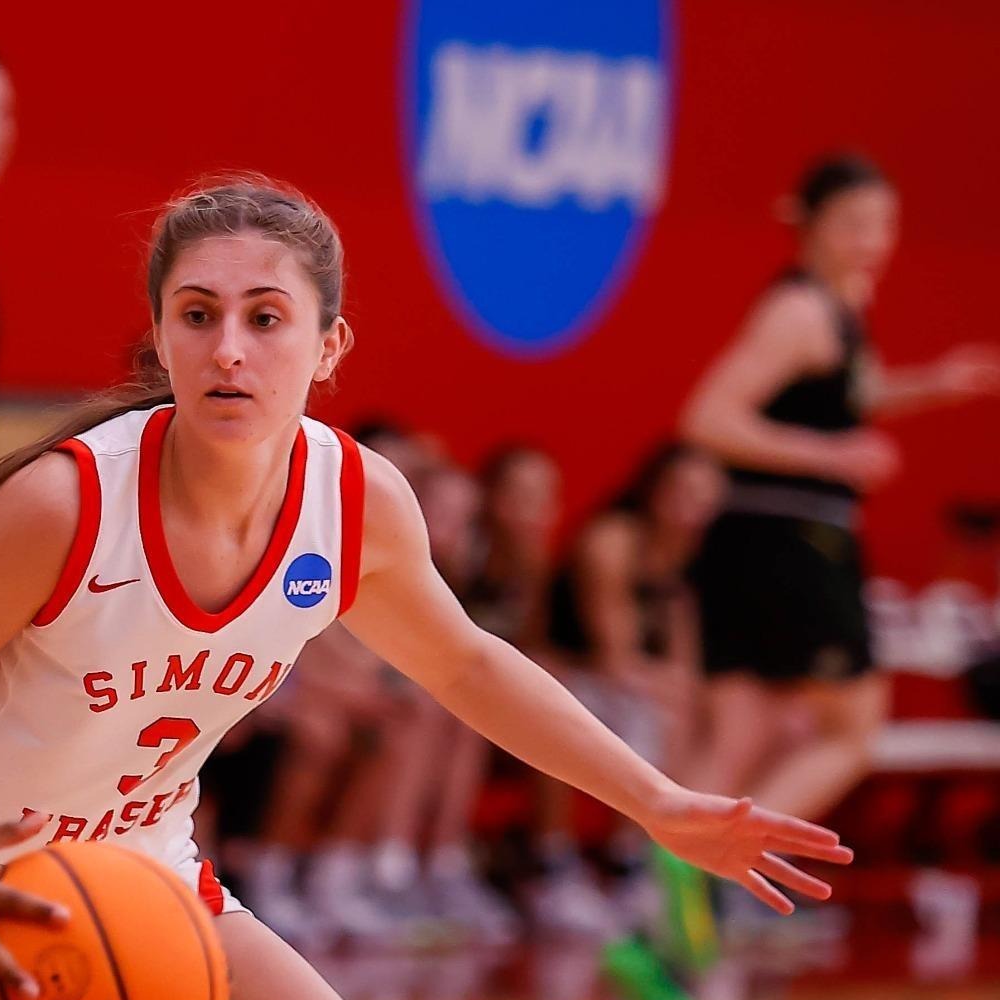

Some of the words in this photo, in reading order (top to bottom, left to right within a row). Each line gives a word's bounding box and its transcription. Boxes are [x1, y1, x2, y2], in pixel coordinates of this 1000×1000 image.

[420, 44, 668, 211] NCAA
[287, 580, 331, 595] NCAA
[83, 650, 293, 713] SIMON
[117, 717, 201, 796] 3
